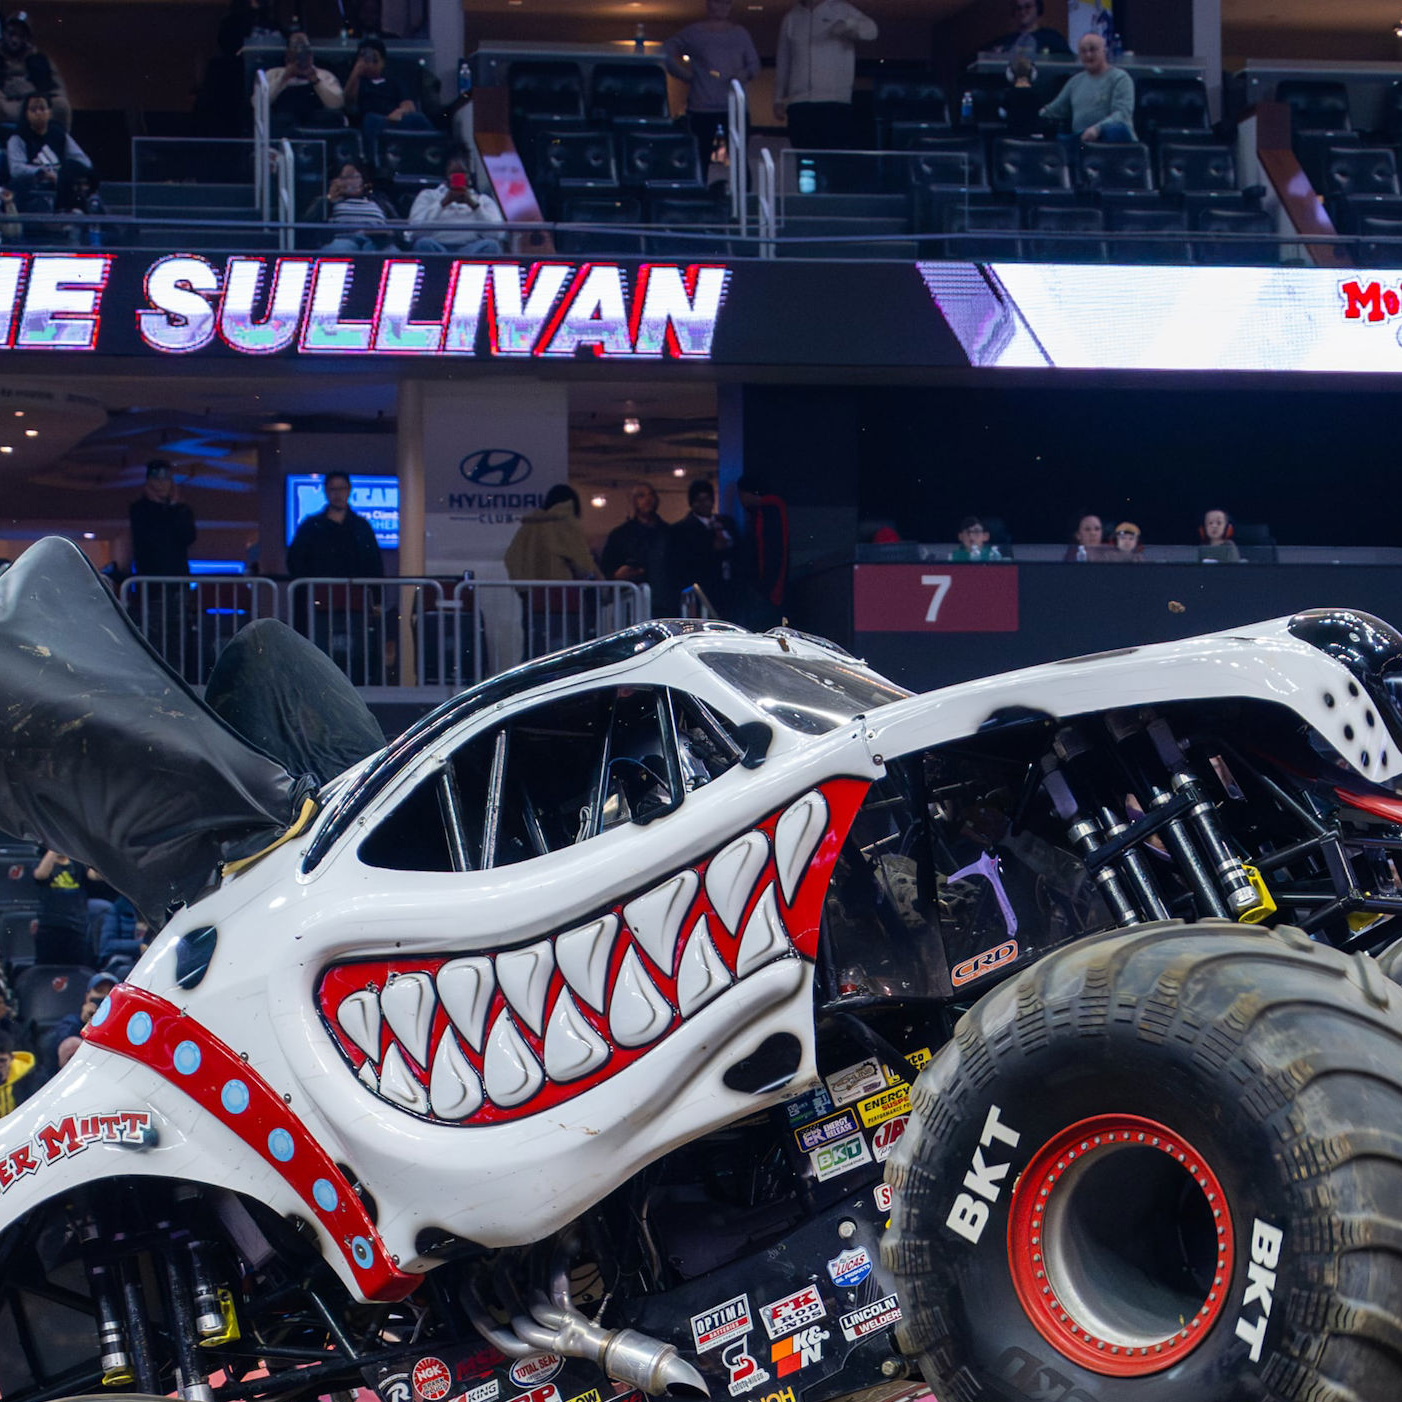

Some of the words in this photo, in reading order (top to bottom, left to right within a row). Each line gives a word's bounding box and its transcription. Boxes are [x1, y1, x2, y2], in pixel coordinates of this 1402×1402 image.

[136, 252, 732, 359] SULLIVAN
[449, 493, 549, 510] HYUNDAI
[478, 513, 517, 525] CLUB
[921, 575, 952, 622] 7
[864, 1085, 911, 1112] ENERGY
[823, 1116, 848, 1132] ENERGY
[826, 1122, 853, 1139] RELEASE
[35, 1112, 151, 1163] MUTT
[818, 1138, 862, 1171] BKT
[945, 1104, 1021, 1244] BKT
[835, 1254, 866, 1277] LUCAS
[845, 1263, 871, 1280] PRODUCTS
[1235, 1218, 1284, 1363] BKT
[771, 1290, 817, 1320] FK
[780, 1302, 820, 1325] ROD
[843, 1297, 897, 1329] LINCOLN
[697, 1301, 746, 1335] OPTIMA
[709, 1321, 740, 1339] BATTERIES
[772, 1311, 822, 1335] ENDS
[792, 1326, 830, 1352] K&
[515, 1360, 540, 1379] TOTAL
[539, 1354, 559, 1372] SEAL
[801, 1342, 822, 1368] N
[417, 1365, 444, 1382] NGK
[422, 1378, 446, 1391] SPARK
